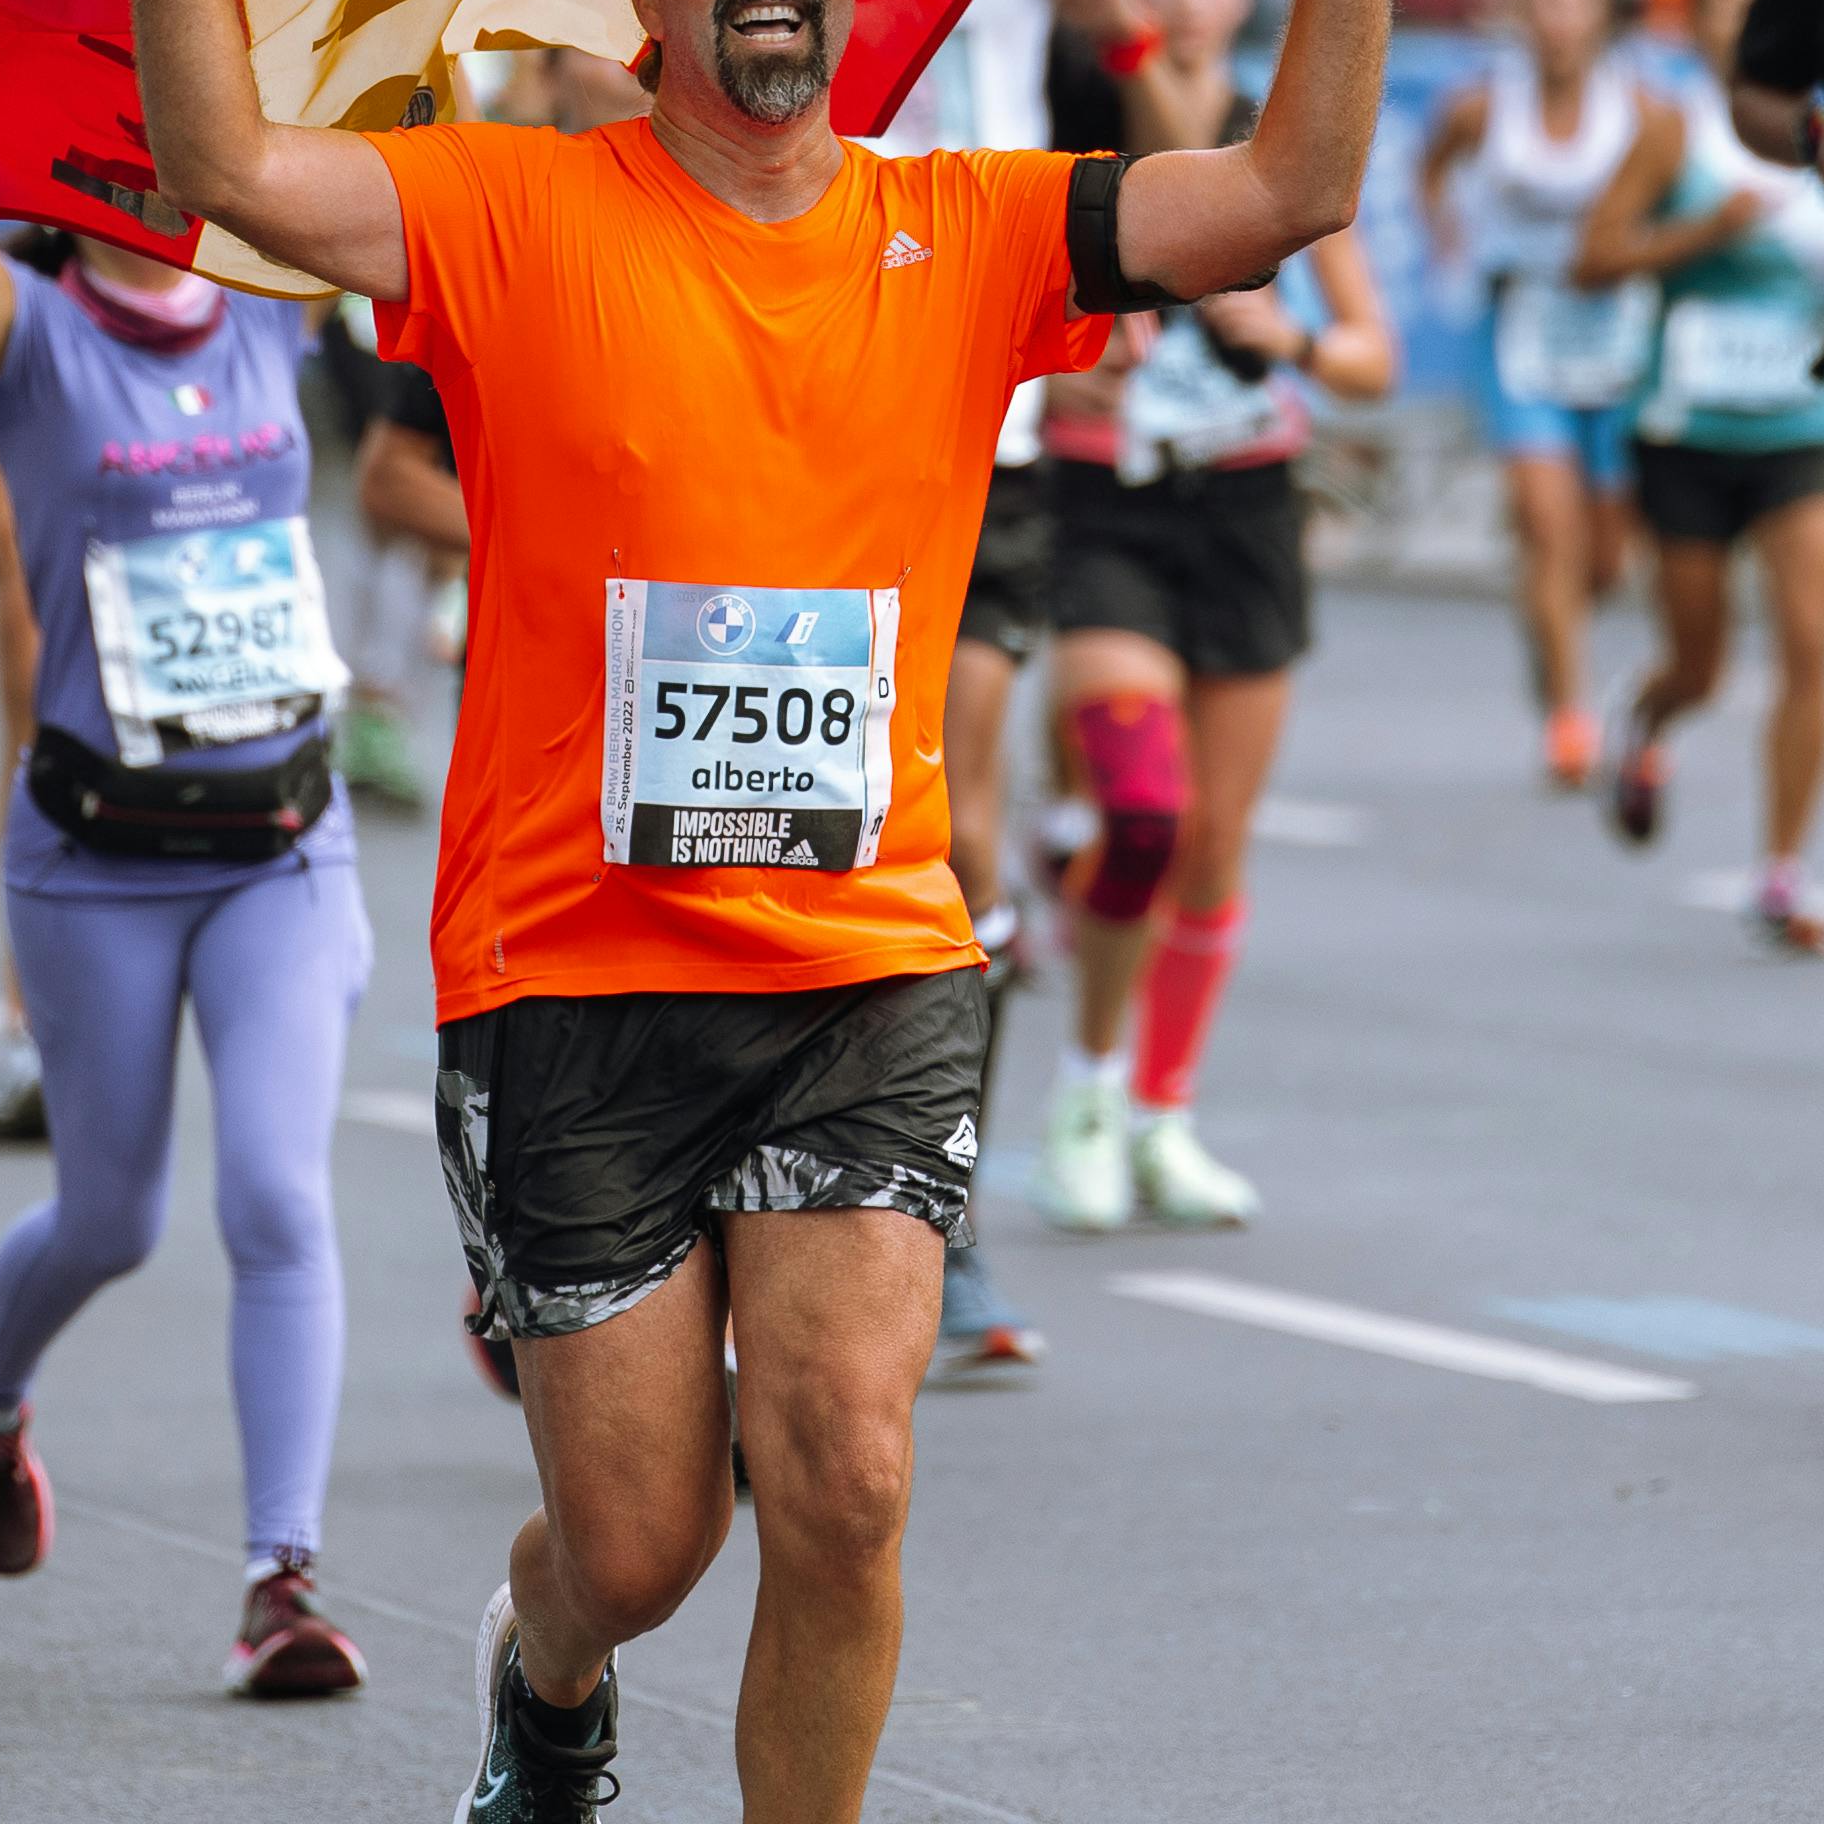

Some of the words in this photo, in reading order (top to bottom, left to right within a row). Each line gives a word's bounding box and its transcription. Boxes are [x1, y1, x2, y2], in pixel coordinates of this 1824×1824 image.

[879, 247, 933, 270] adidas
[705, 598, 749, 616] BMW
[609, 608, 624, 764] BERLIN-MARATHON
[878, 677, 890, 699] D
[623, 700, 634, 735] 2022
[654, 681, 855, 746] 57508
[607, 767, 620, 806] BMW
[617, 736, 633, 811] September
[692, 761, 815, 792] alberto
[616, 813, 627, 834] 25.
[672, 811, 793, 839] IMPOSSIBLE
[671, 837, 692, 864] IS
[694, 837, 781, 865] NOTHING
[781, 854, 819, 867] adidas
